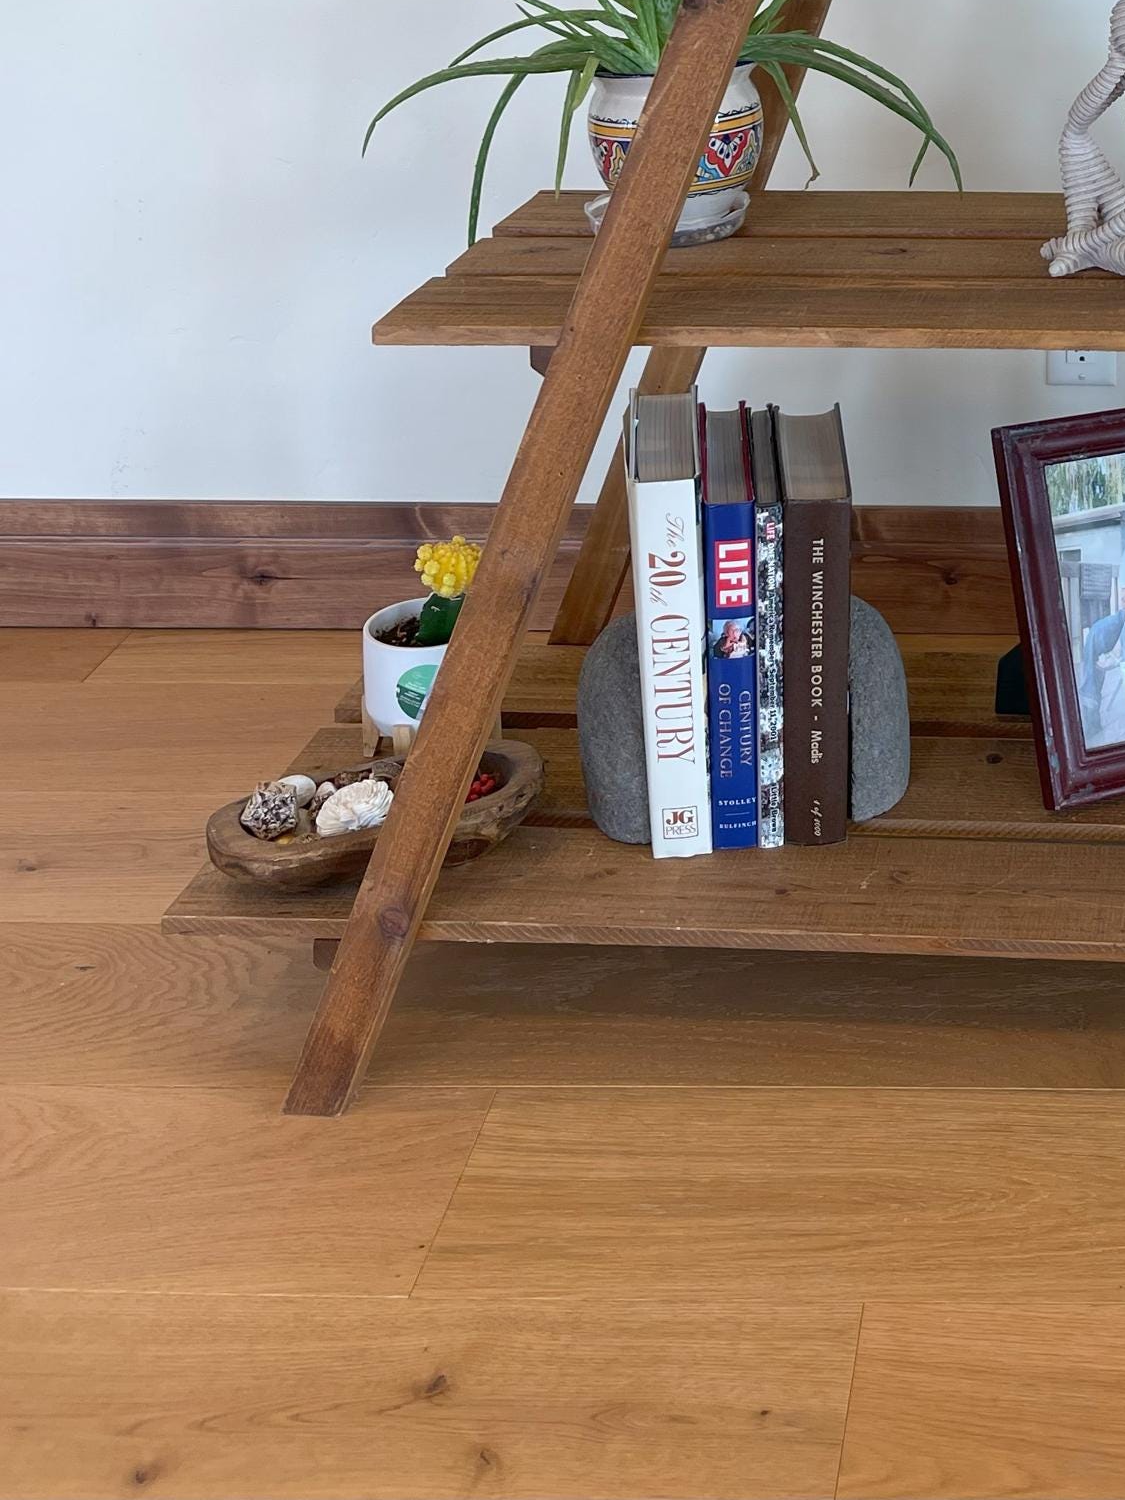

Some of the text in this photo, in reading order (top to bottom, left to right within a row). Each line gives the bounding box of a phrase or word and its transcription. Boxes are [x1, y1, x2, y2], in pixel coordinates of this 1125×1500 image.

[766, 522, 776, 541] LIFE
[767, 543, 775, 560] ONE
[812, 538, 824, 564] THE
[718, 542, 750, 605] LIFE
[767, 562, 776, 590] NATION
[811, 570, 823, 659] WINCHESTER
[648, 512, 696, 765] The 20th CENTURY
[768, 669, 777, 708] September
[811, 665, 823, 708] BOOK
[718, 683, 733, 779] OF CHANGE
[738, 690, 753, 766] CENTURY
[811, 730, 823, 764] Madis
[718, 796, 757, 806] STOLLEY
[811, 807, 823, 818] of
[665, 809, 694, 825] JG
[665, 824, 697, 837] PRESS
[719, 820, 757, 829] BULFINCH
